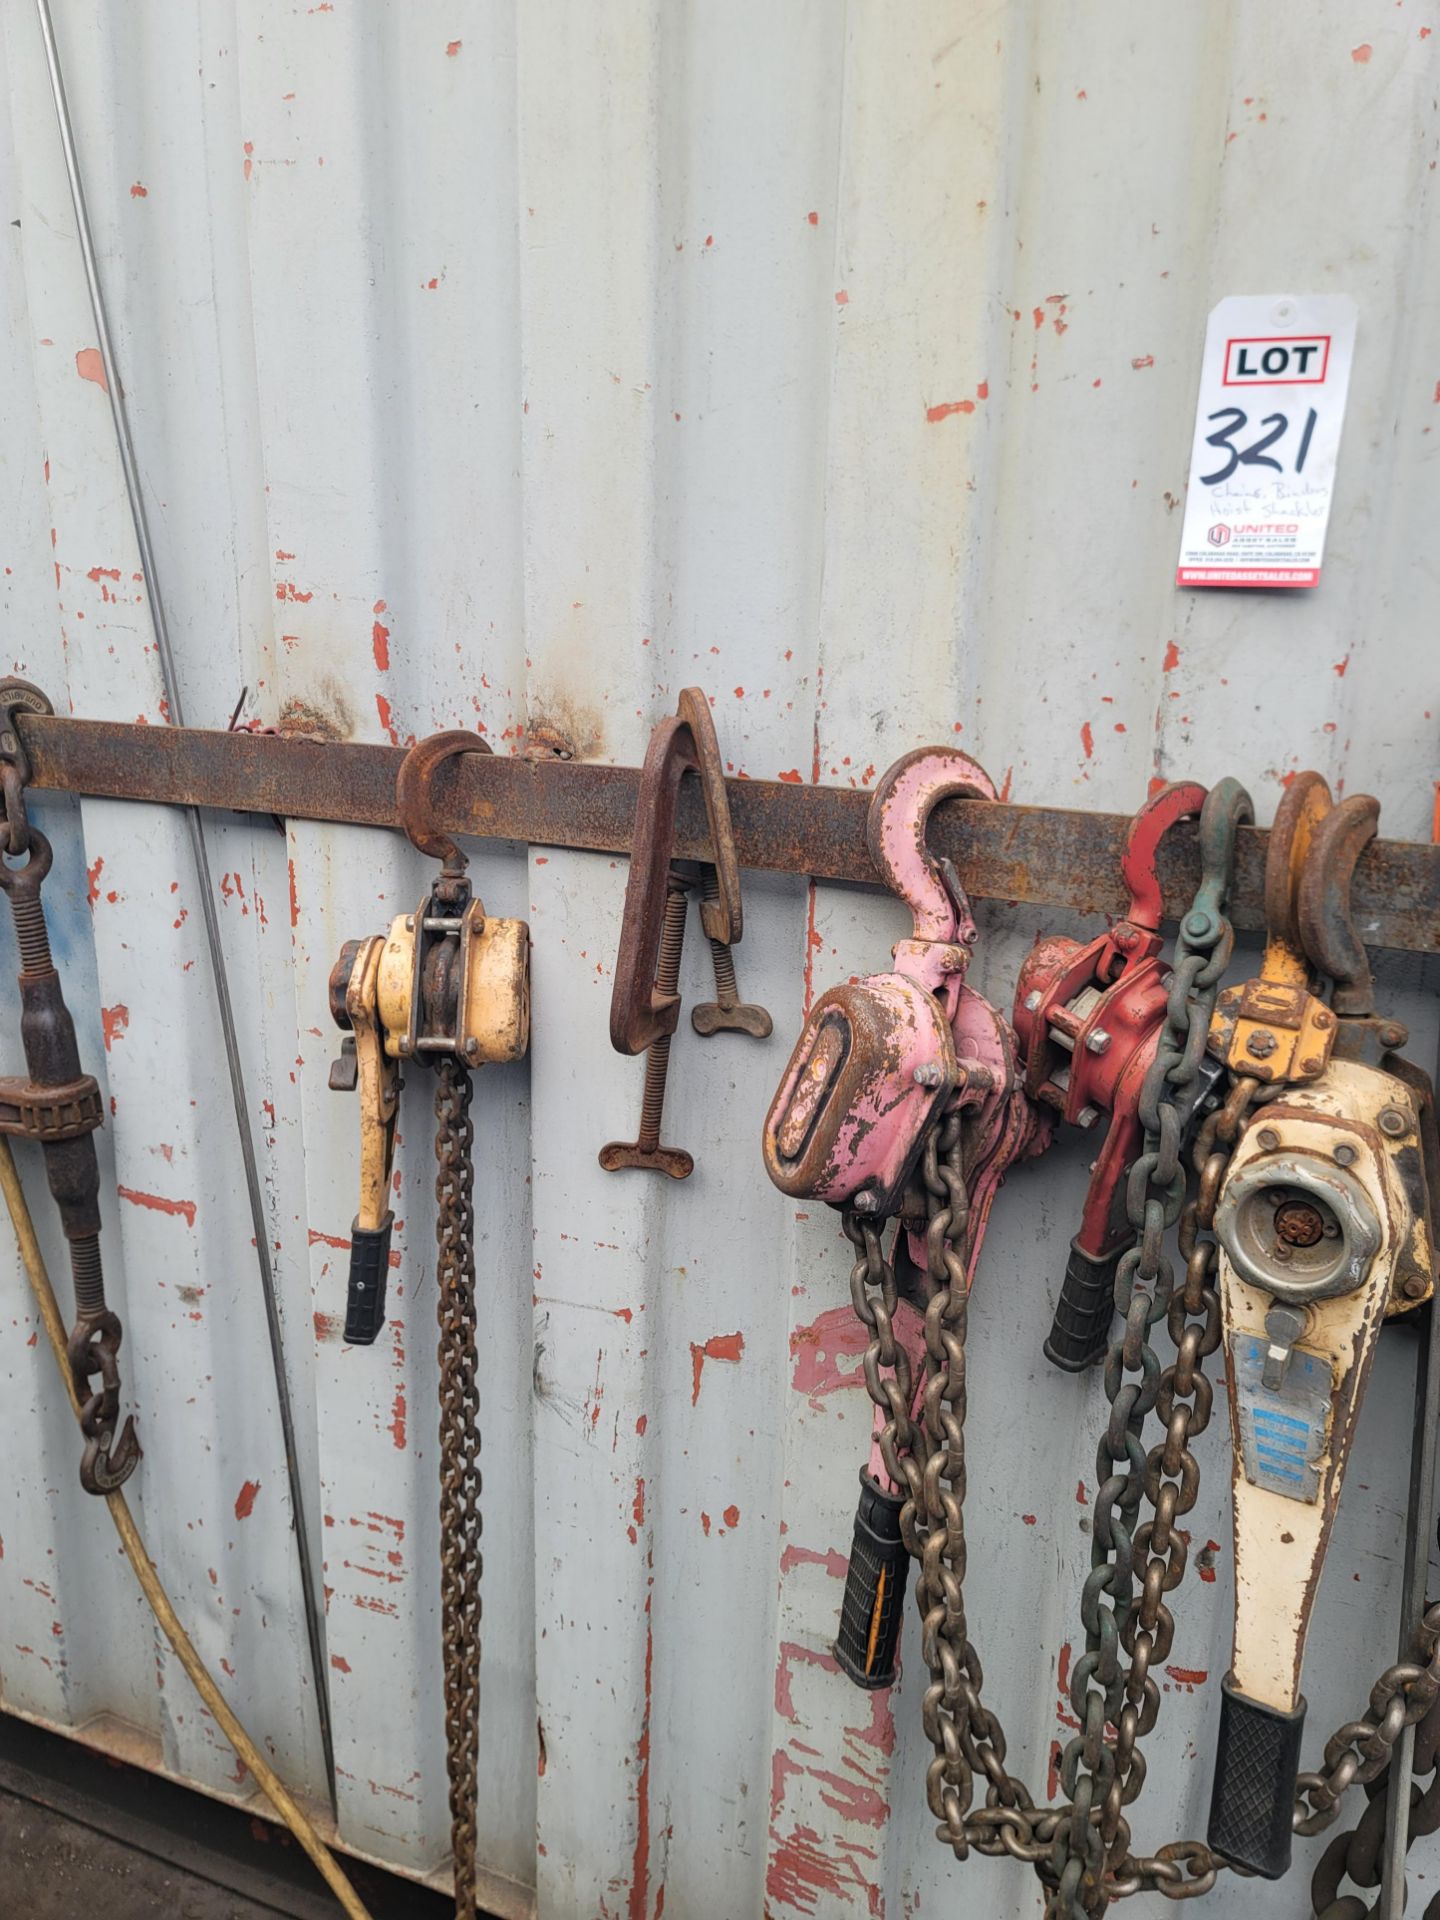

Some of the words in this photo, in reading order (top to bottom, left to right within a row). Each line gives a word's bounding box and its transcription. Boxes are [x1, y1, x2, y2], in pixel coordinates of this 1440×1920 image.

[1236, 346, 1318, 375] LOT
[1199, 407, 1317, 486] 321
[1233, 523, 1299, 534] UNITED
